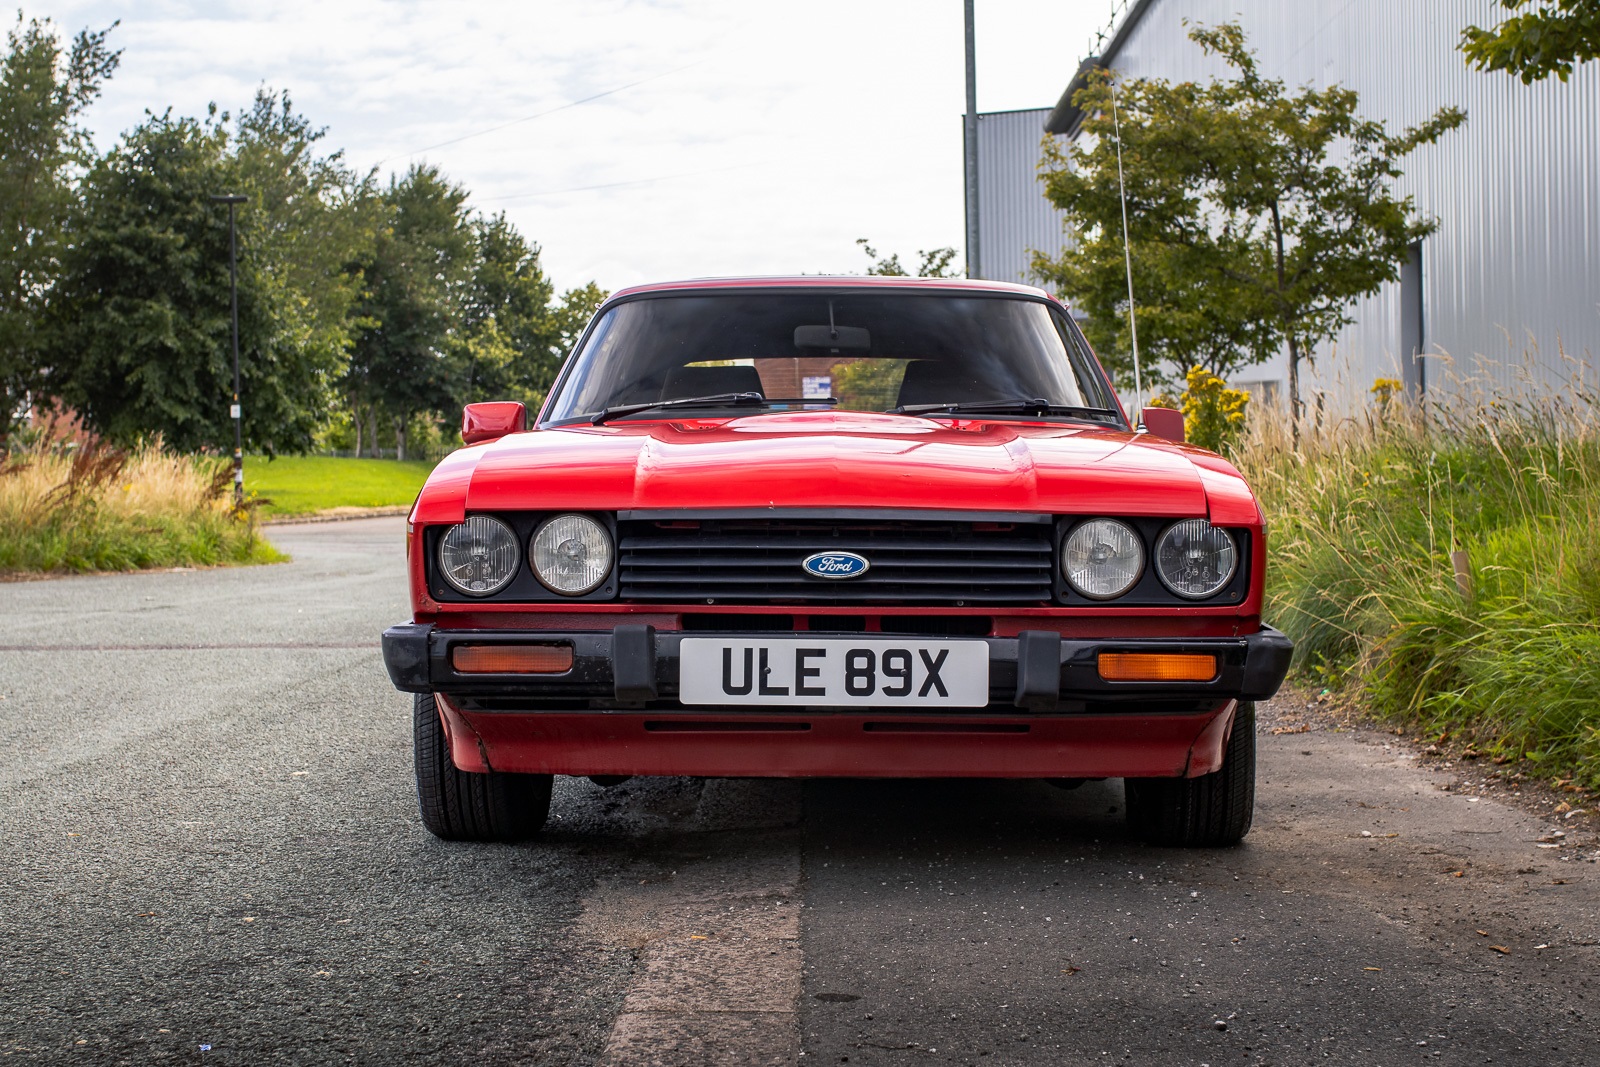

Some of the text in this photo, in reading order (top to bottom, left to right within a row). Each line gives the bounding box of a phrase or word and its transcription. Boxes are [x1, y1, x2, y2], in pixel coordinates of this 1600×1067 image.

[818, 556, 853, 572] Ford
[722, 647, 949, 698] ULE 89X
